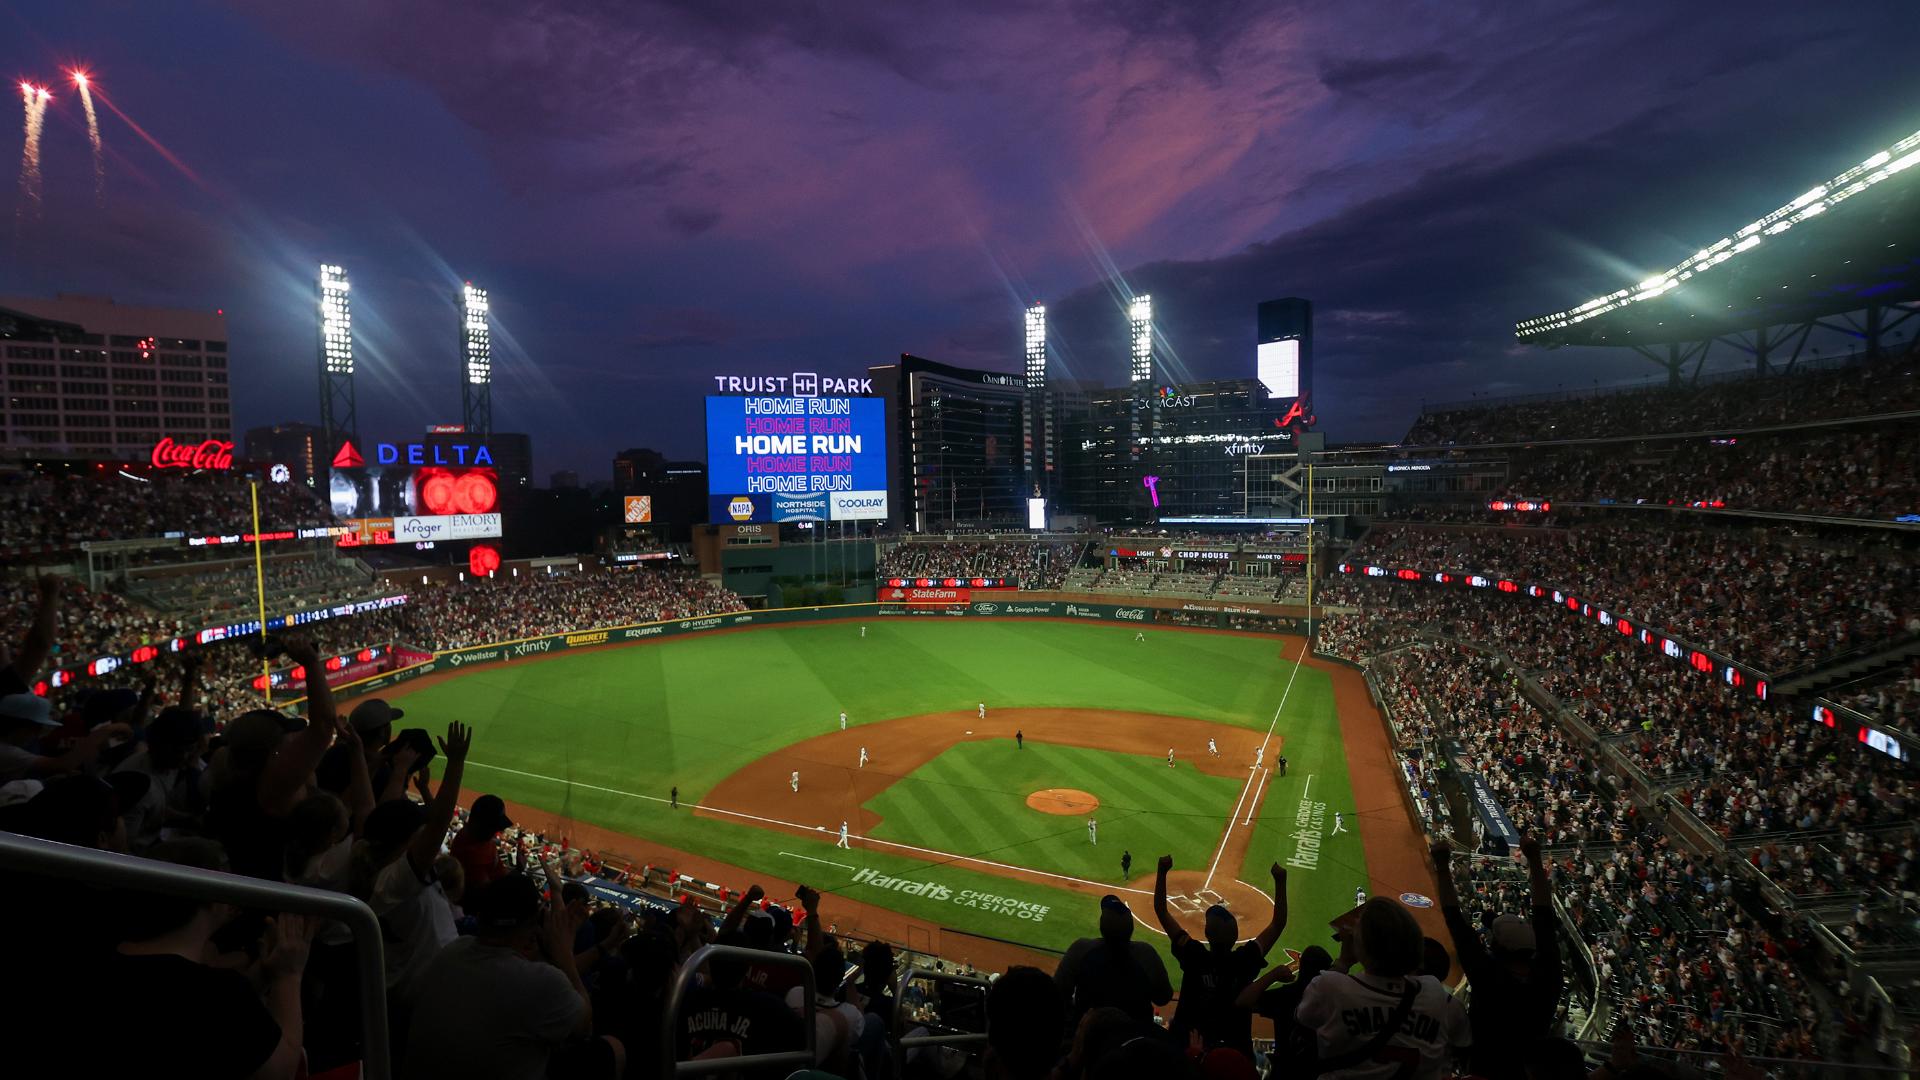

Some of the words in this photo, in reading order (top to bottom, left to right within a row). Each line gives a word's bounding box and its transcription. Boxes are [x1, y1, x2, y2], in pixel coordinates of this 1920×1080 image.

[714, 375, 789, 392] TRUIST
[822, 377, 873, 393] PARK
[745, 398, 804, 415] HOME
[809, 398, 850, 415] RUN
[745, 417, 805, 435] HOME
[809, 417, 851, 434] RUN
[735, 435, 807, 455] HOME
[812, 435, 862, 454] RUN
[1224, 443, 1265, 457] xfinity
[377, 443, 493, 465] DELTA
[747, 456, 807, 473] HOME
[810, 455, 852, 472] RUN
[747, 475, 807, 493] HOME
[811, 474, 852, 491] RUN
[732, 503, 751, 514] NAPA
[776, 500, 826, 509] NORTHSIDE
[838, 498, 884, 508] COOLRAY
[403, 518, 442, 539] Kroger
[452, 514, 499, 527] EMORY
[737, 525, 762, 534] ORIS
[692, 617, 722, 627] HYUNDAI
[566, 631, 609, 645] QUIKRETE
[625, 626, 663, 638] EQUIFAX
[515, 640, 551, 656] xfinity
[463, 651, 498, 663] Wellstar
[1295, 799, 1313, 828] CHEROKEE
[1310, 801, 1327, 830] CASINOS
[953, 896, 1045, 922] CASINOS
[959, 890, 1050, 915] CHEROKEE
[687, 1007, 728, 1034] ACUÑA
